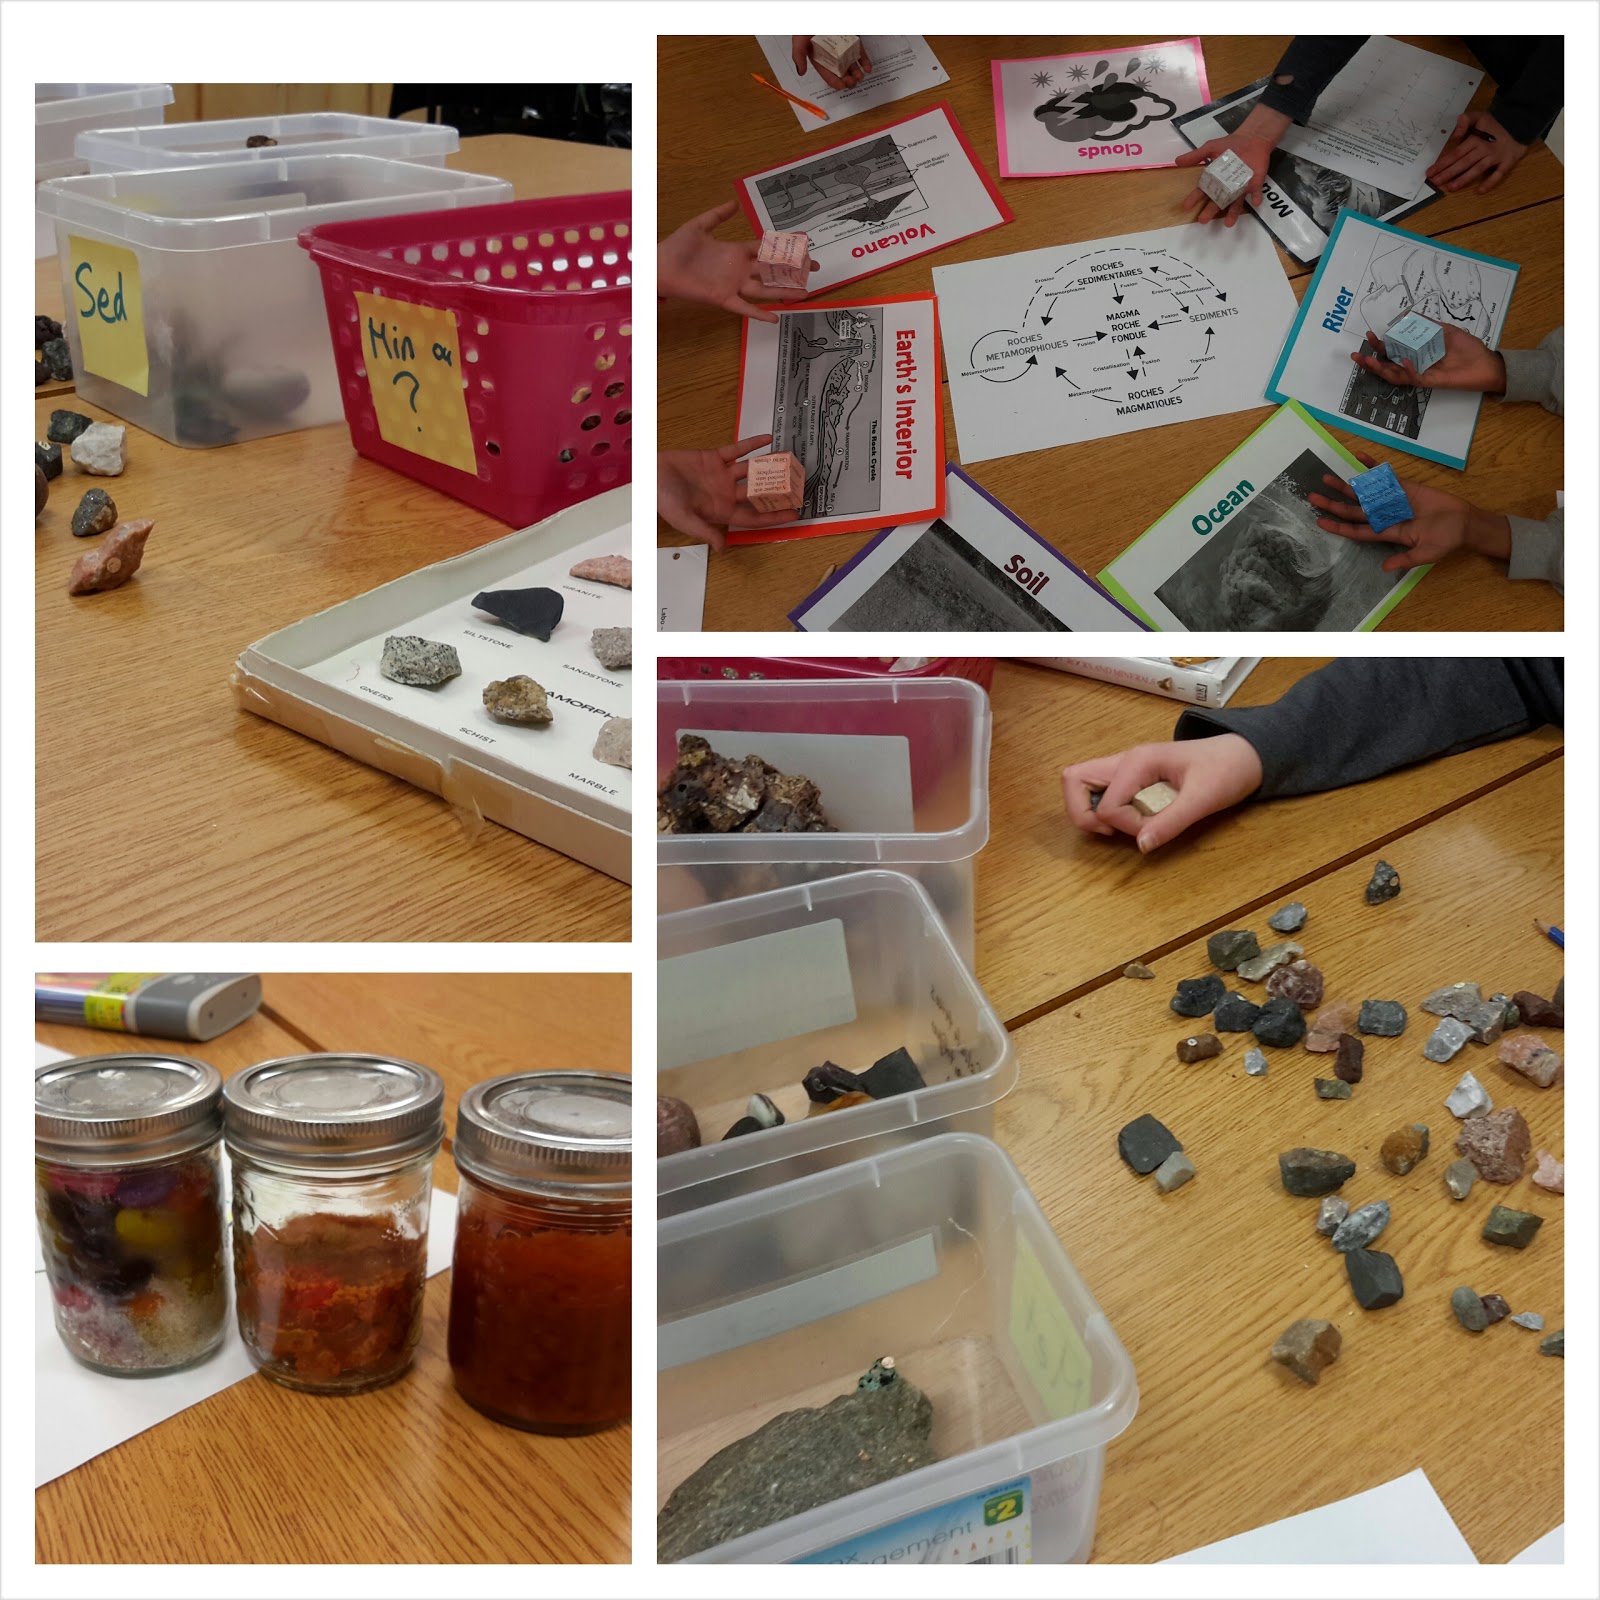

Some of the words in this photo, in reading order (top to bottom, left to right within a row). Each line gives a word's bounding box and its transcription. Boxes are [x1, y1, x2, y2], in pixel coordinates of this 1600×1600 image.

[1078, 143, 1143, 159] Clouds
[851, 223, 936, 258] Volcano
[1142, 248, 1166, 256] Transport
[1090, 261, 1124, 273] ROCHES
[1077, 268, 1143, 286] SEDIMENTAIRES
[75, 262, 128, 324] Sed
[1106, 309, 1140, 322] MAGMA
[1160, 312, 1180, 320] Fusion
[1189, 308, 1238, 322] SEDIMENTS
[1322, 285, 1354, 333] River
[1111, 320, 1141, 332] ROCHE
[368, 317, 415, 361] Min
[1007, 334, 1043, 346] ROCHES
[1077, 340, 1096, 348] Fusion
[1111, 330, 1148, 344] FONDUE
[986, 340, 1069, 362] METAMORPHIQUES
[1092, 362, 1130, 372] Cristallisation
[1190, 356, 1216, 364] Transport
[961, 366, 1005, 377] Métamorphisme
[1068, 386, 1112, 398] Métamorphisme
[1128, 386, 1164, 400] ROCHES
[392, 371, 420, 432] ?
[1116, 396, 1183, 416] MAGMATIQUES
[896, 399, 918, 480] Interior
[1191, 479, 1255, 536] Ocean
[1003, 554, 1050, 596] Soil
[562, 585, 603, 600] GRANITE
[660, 608, 668, 624] Labo
[463, 629, 514, 649] SILTSTONE
[562, 664, 624, 688] SANDSTONE
[359, 685, 394, 702] GNEISS
[459, 727, 496, 745] SCHIST
[568, 772, 618, 796] MARBLE
